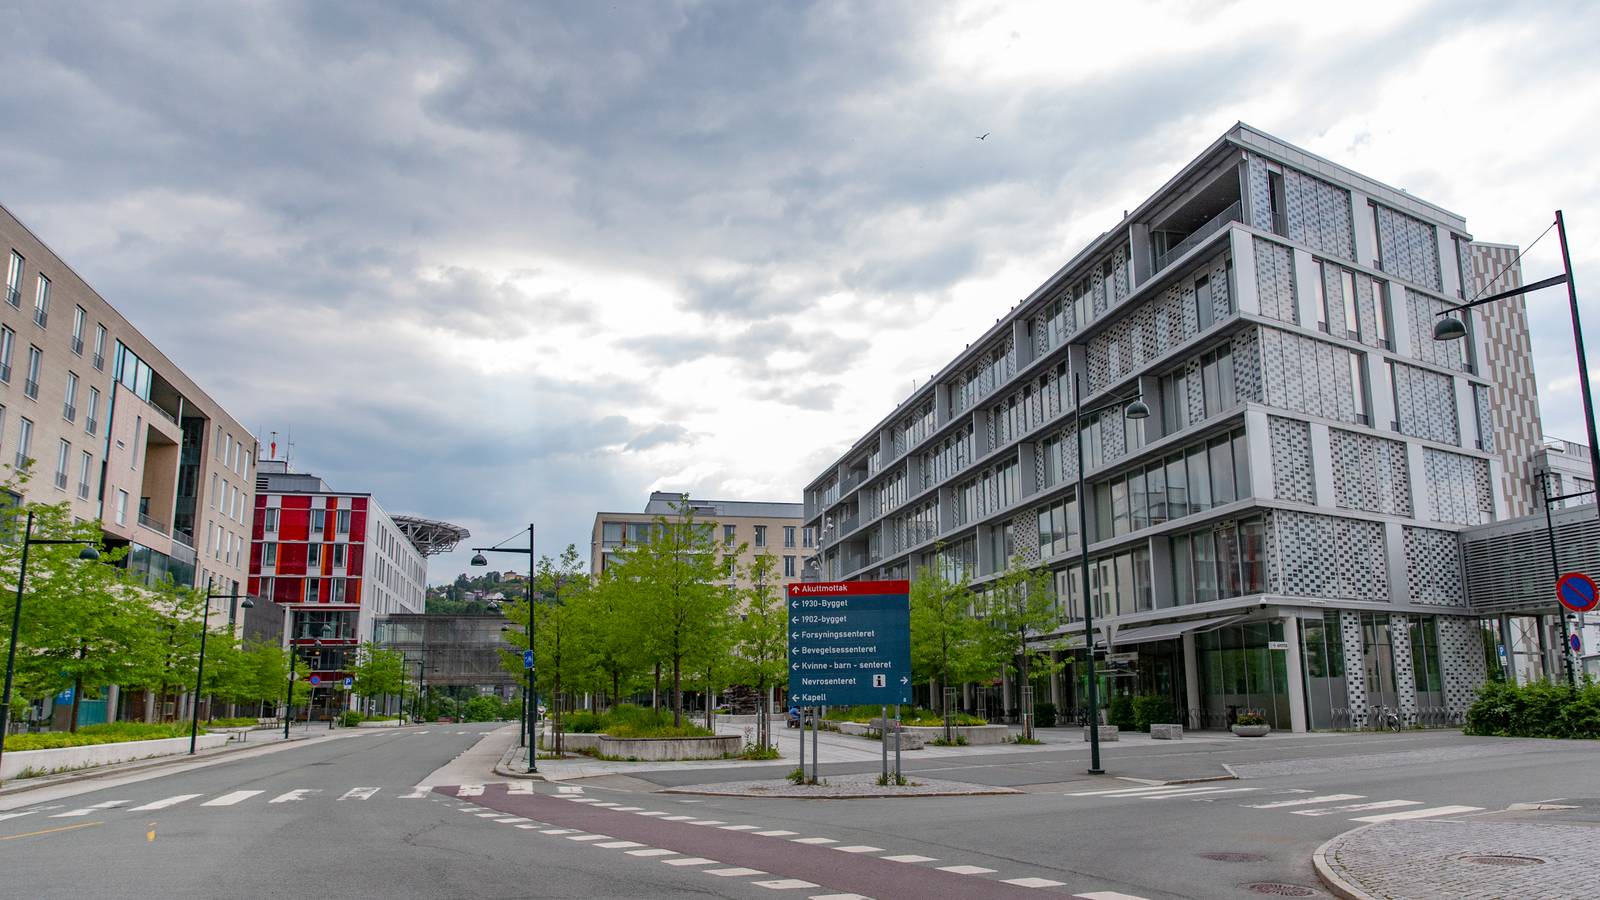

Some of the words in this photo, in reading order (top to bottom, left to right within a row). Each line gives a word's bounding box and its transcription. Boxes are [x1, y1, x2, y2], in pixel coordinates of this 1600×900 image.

[801, 584, 848, 593] Akuttmottak
[801, 599, 848, 608] 1930-Bygget
[801, 615, 847, 624] 1902-bygget
[801, 630, 875, 640] Forsyningssenteret
[801, 646, 877, 655] Bevegelsessenteret
[801, 662, 828, 670] Kvinne
[859, 661, 891, 669] senteret
[801, 677, 856, 685] Nevrosenteret
[801, 693, 826, 702] Kapell
